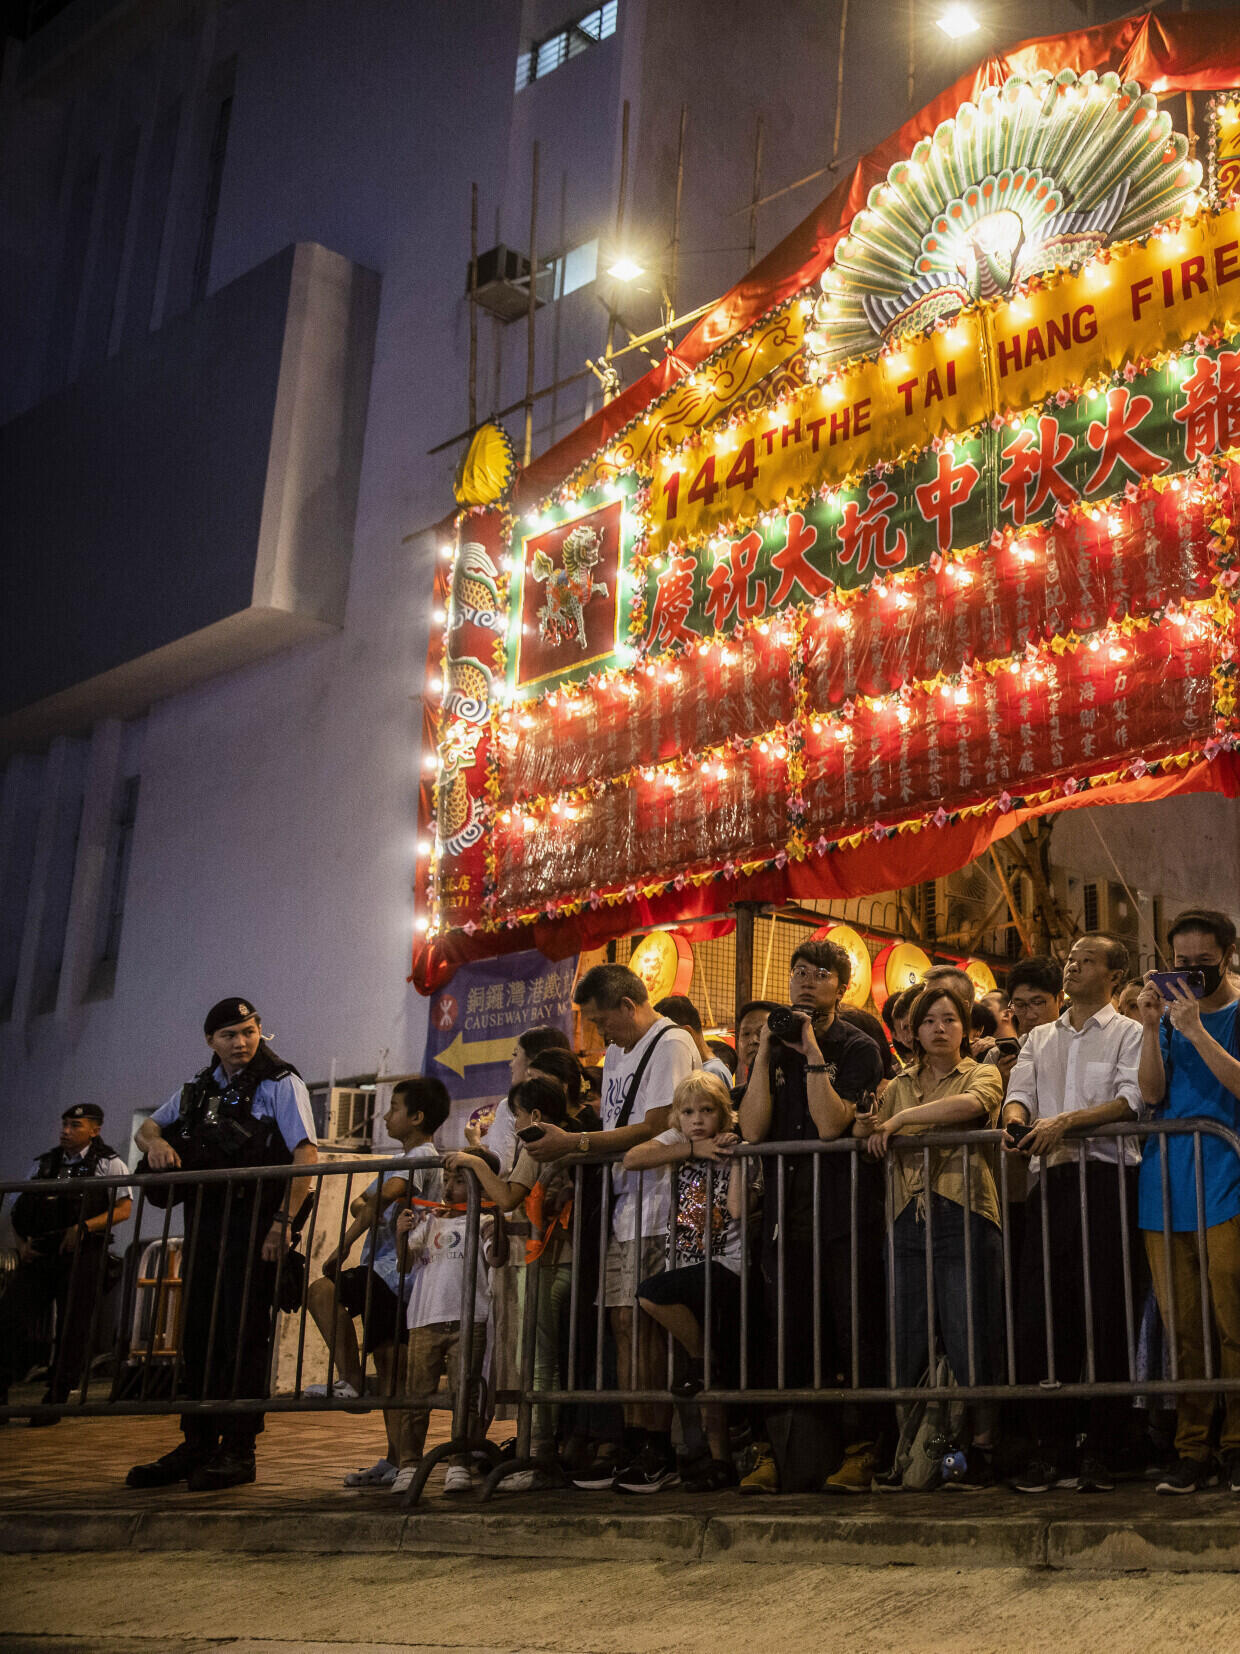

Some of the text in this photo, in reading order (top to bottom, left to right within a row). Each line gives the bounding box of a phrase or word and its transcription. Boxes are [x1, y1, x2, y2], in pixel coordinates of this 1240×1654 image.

[806, 398, 872, 454] THE
[897, 360, 958, 417] TAI
[999, 304, 1098, 377] HANG
[1130, 241, 1240, 321] FIRE
[464, 1009, 528, 1030] CAUSEWAY
[530, 1004, 553, 1021] BAY
